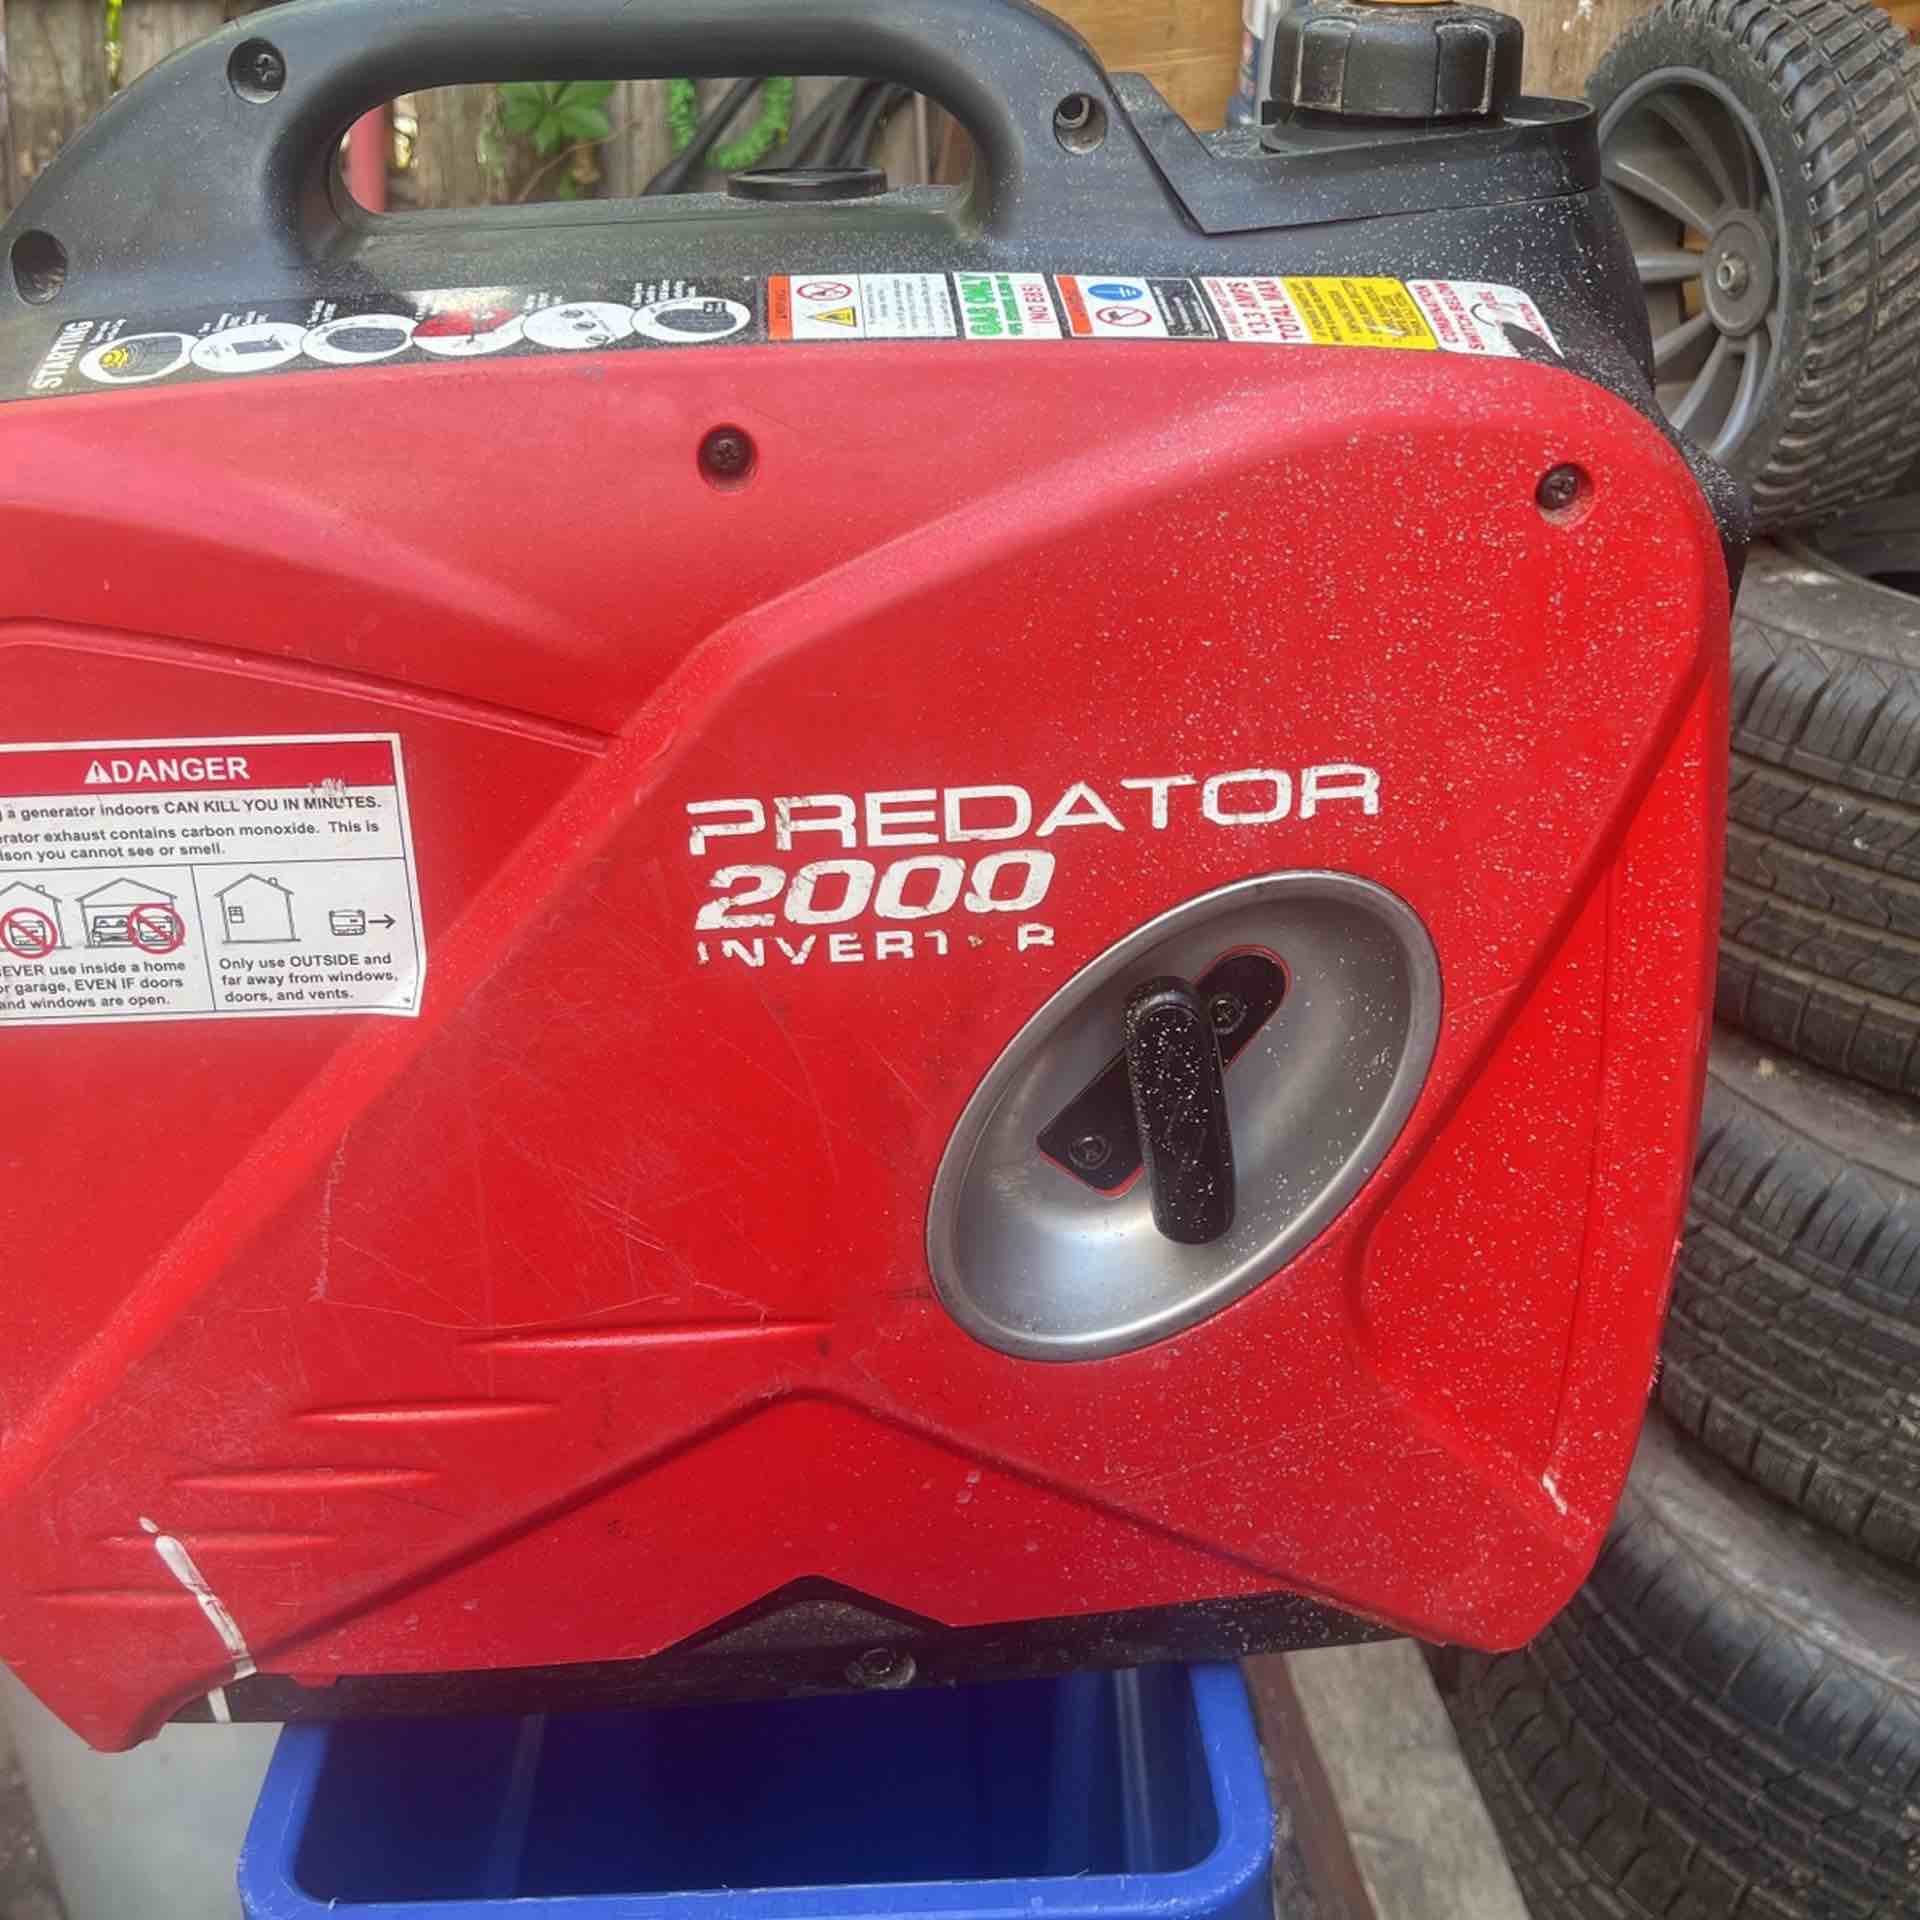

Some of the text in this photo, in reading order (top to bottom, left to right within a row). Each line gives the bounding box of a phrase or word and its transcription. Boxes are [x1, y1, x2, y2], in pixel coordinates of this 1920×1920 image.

[1269, 303, 1303, 340] TOTAL
[32, 321, 94, 389] STARTING
[111, 757, 250, 784] DANGER
[7, 809, 16, 819] a
[21, 806, 96, 822] generator
[100, 803, 160, 817] indoors
[164, 801, 199, 815] CAN
[204, 799, 240, 813] KILL
[244, 798, 278, 812] YOU
[284, 797, 299, 810] IN
[304, 795, 382, 811] MINUTES.
[686, 763, 1382, 855] PREDATOR
[44, 829, 107, 843] exhaust
[110, 826, 176, 841] contains
[181, 824, 235, 838] carbon
[239, 821, 320, 836] monoxide.
[328, 820, 362, 833] This
[366, 819, 379, 832] is
[38, 850, 66, 863] you
[70, 846, 123, 860] cannot
[127, 846, 154, 857] see
[159, 845, 175, 856] or
[180, 841, 225, 856] smell.
[695, 849, 1056, 931] 2000
[695, 922, 1056, 969] INVERTR
[0, 961, 186, 977] EVER use inside a home
[219, 952, 392, 972] Only use OUTSIDE and
[74, 978, 117, 991] EVEN
[121, 977, 135, 990] IF
[139, 976, 184, 989] doors
[222, 974, 241, 986] far
[246, 974, 284, 987] away
[289, 972, 324, 984] from
[30, 996, 96, 1010] windows
[100, 997, 125, 1007] are
[128, 994, 171, 1009] open.
[225, 987, 354, 1004] doors, and vents.
